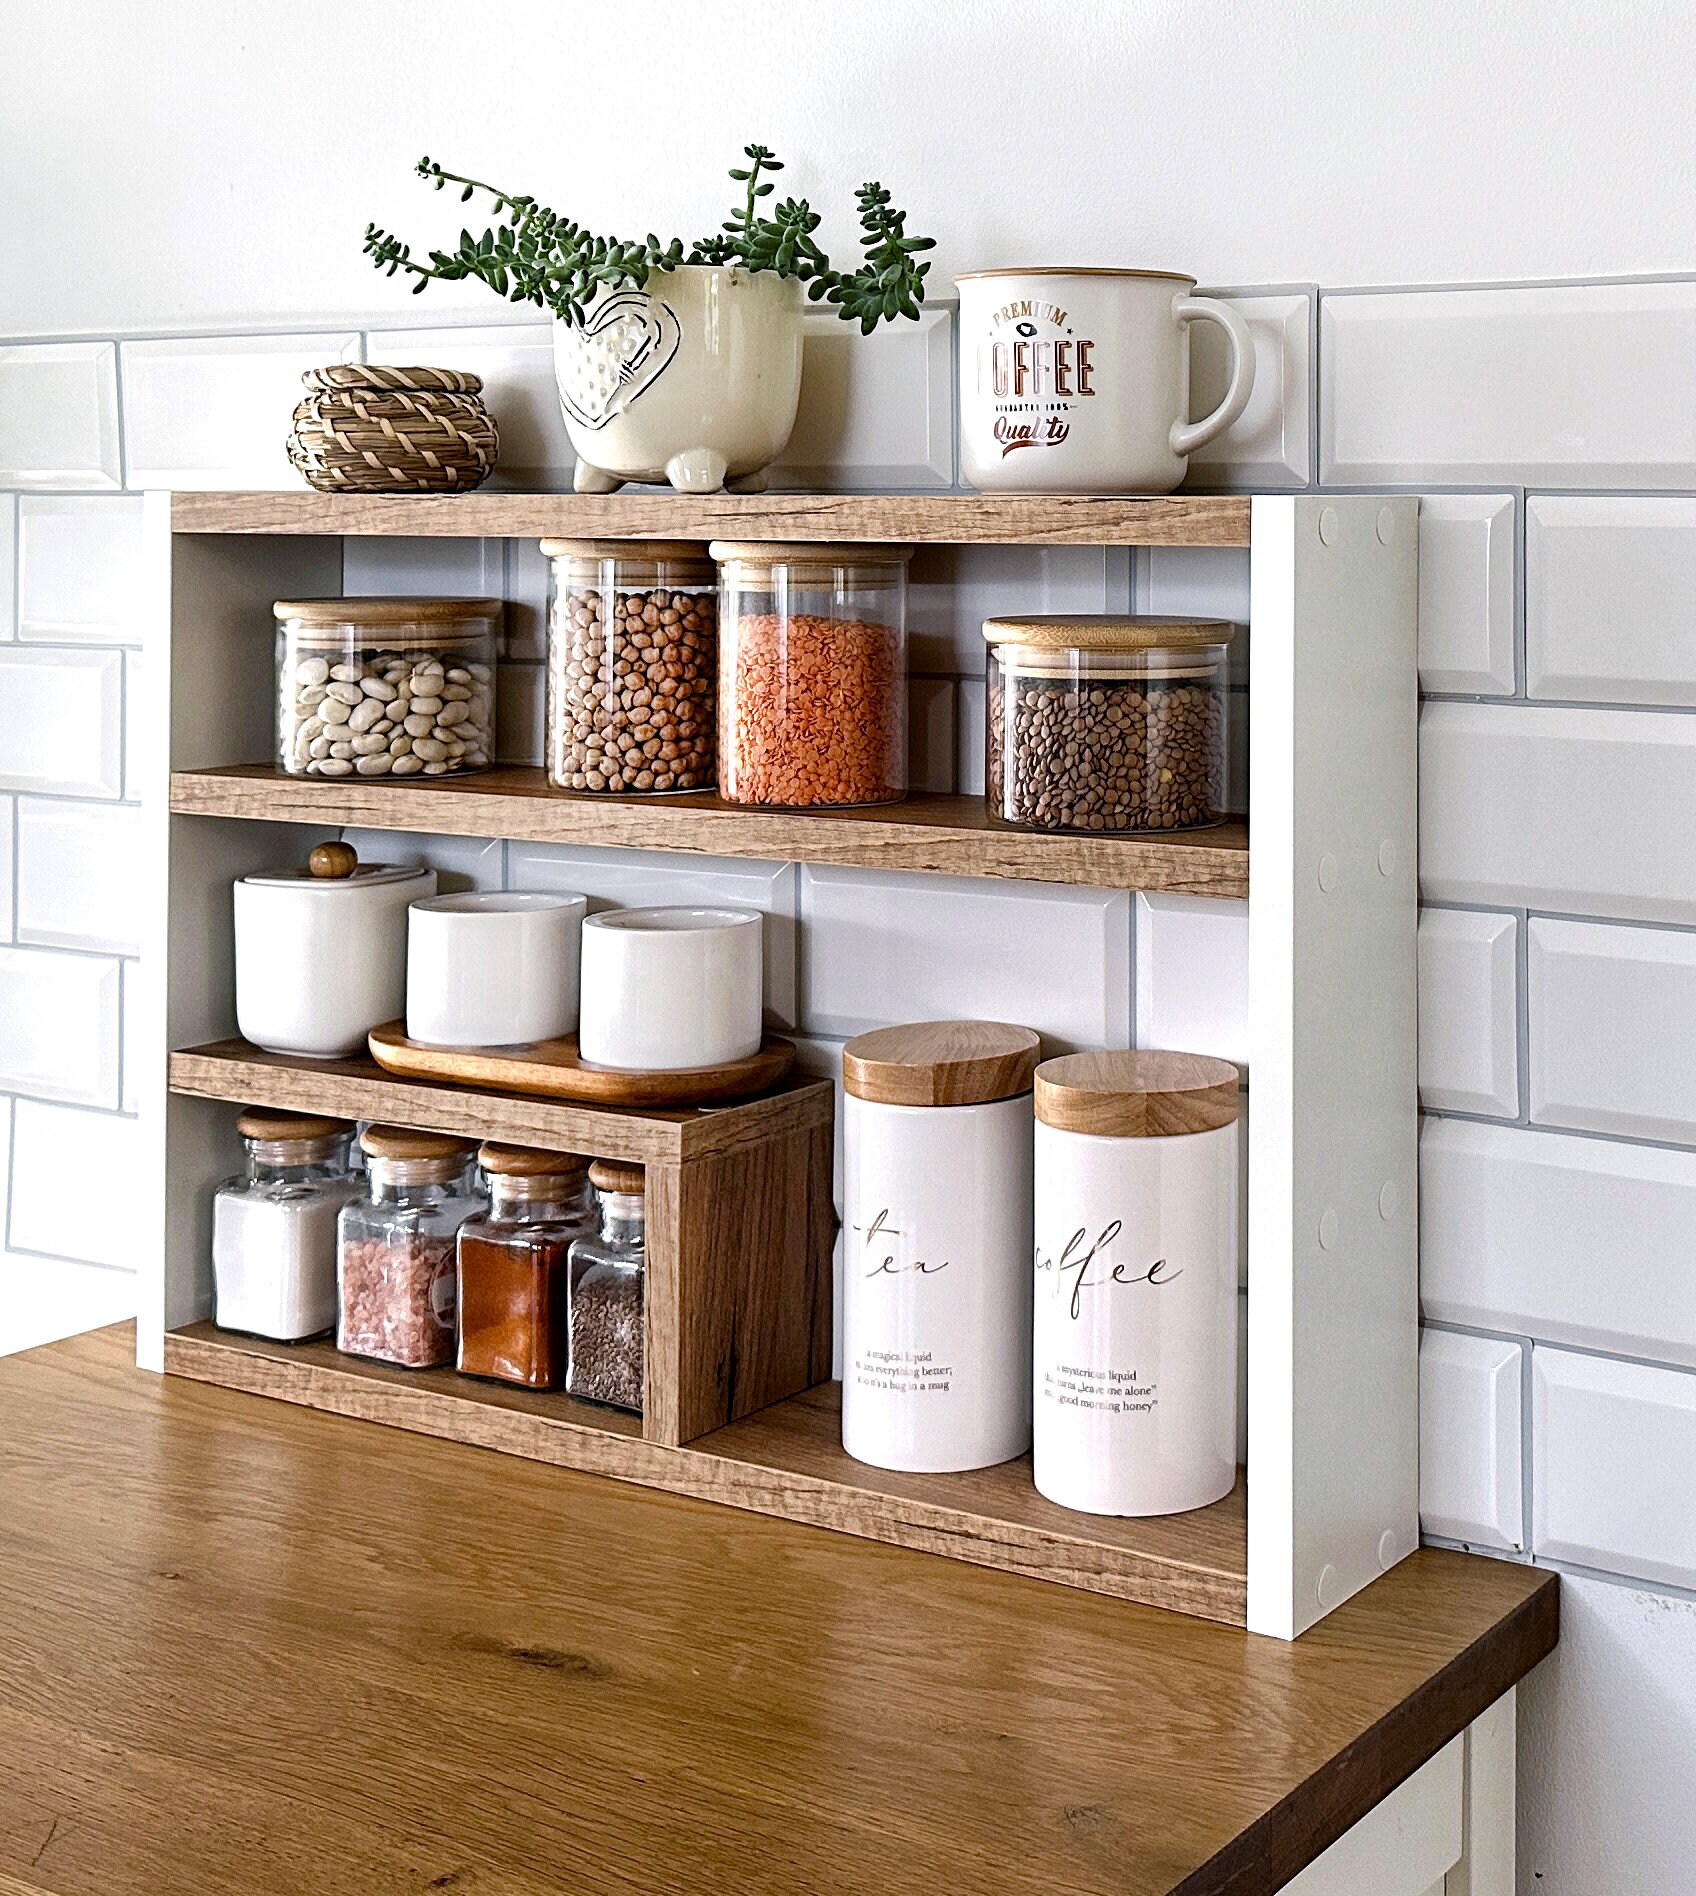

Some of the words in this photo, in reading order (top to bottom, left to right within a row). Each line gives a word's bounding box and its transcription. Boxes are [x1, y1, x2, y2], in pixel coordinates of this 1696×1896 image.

[993, 300, 1068, 328] PREMIUM
[977, 340, 1096, 398] OFFEE
[993, 415, 1070, 448] Quality
[928, 1381, 950, 1391] mug
[1108, 1369, 1137, 1383] liquid
[1107, 1387, 1122, 1396] me
